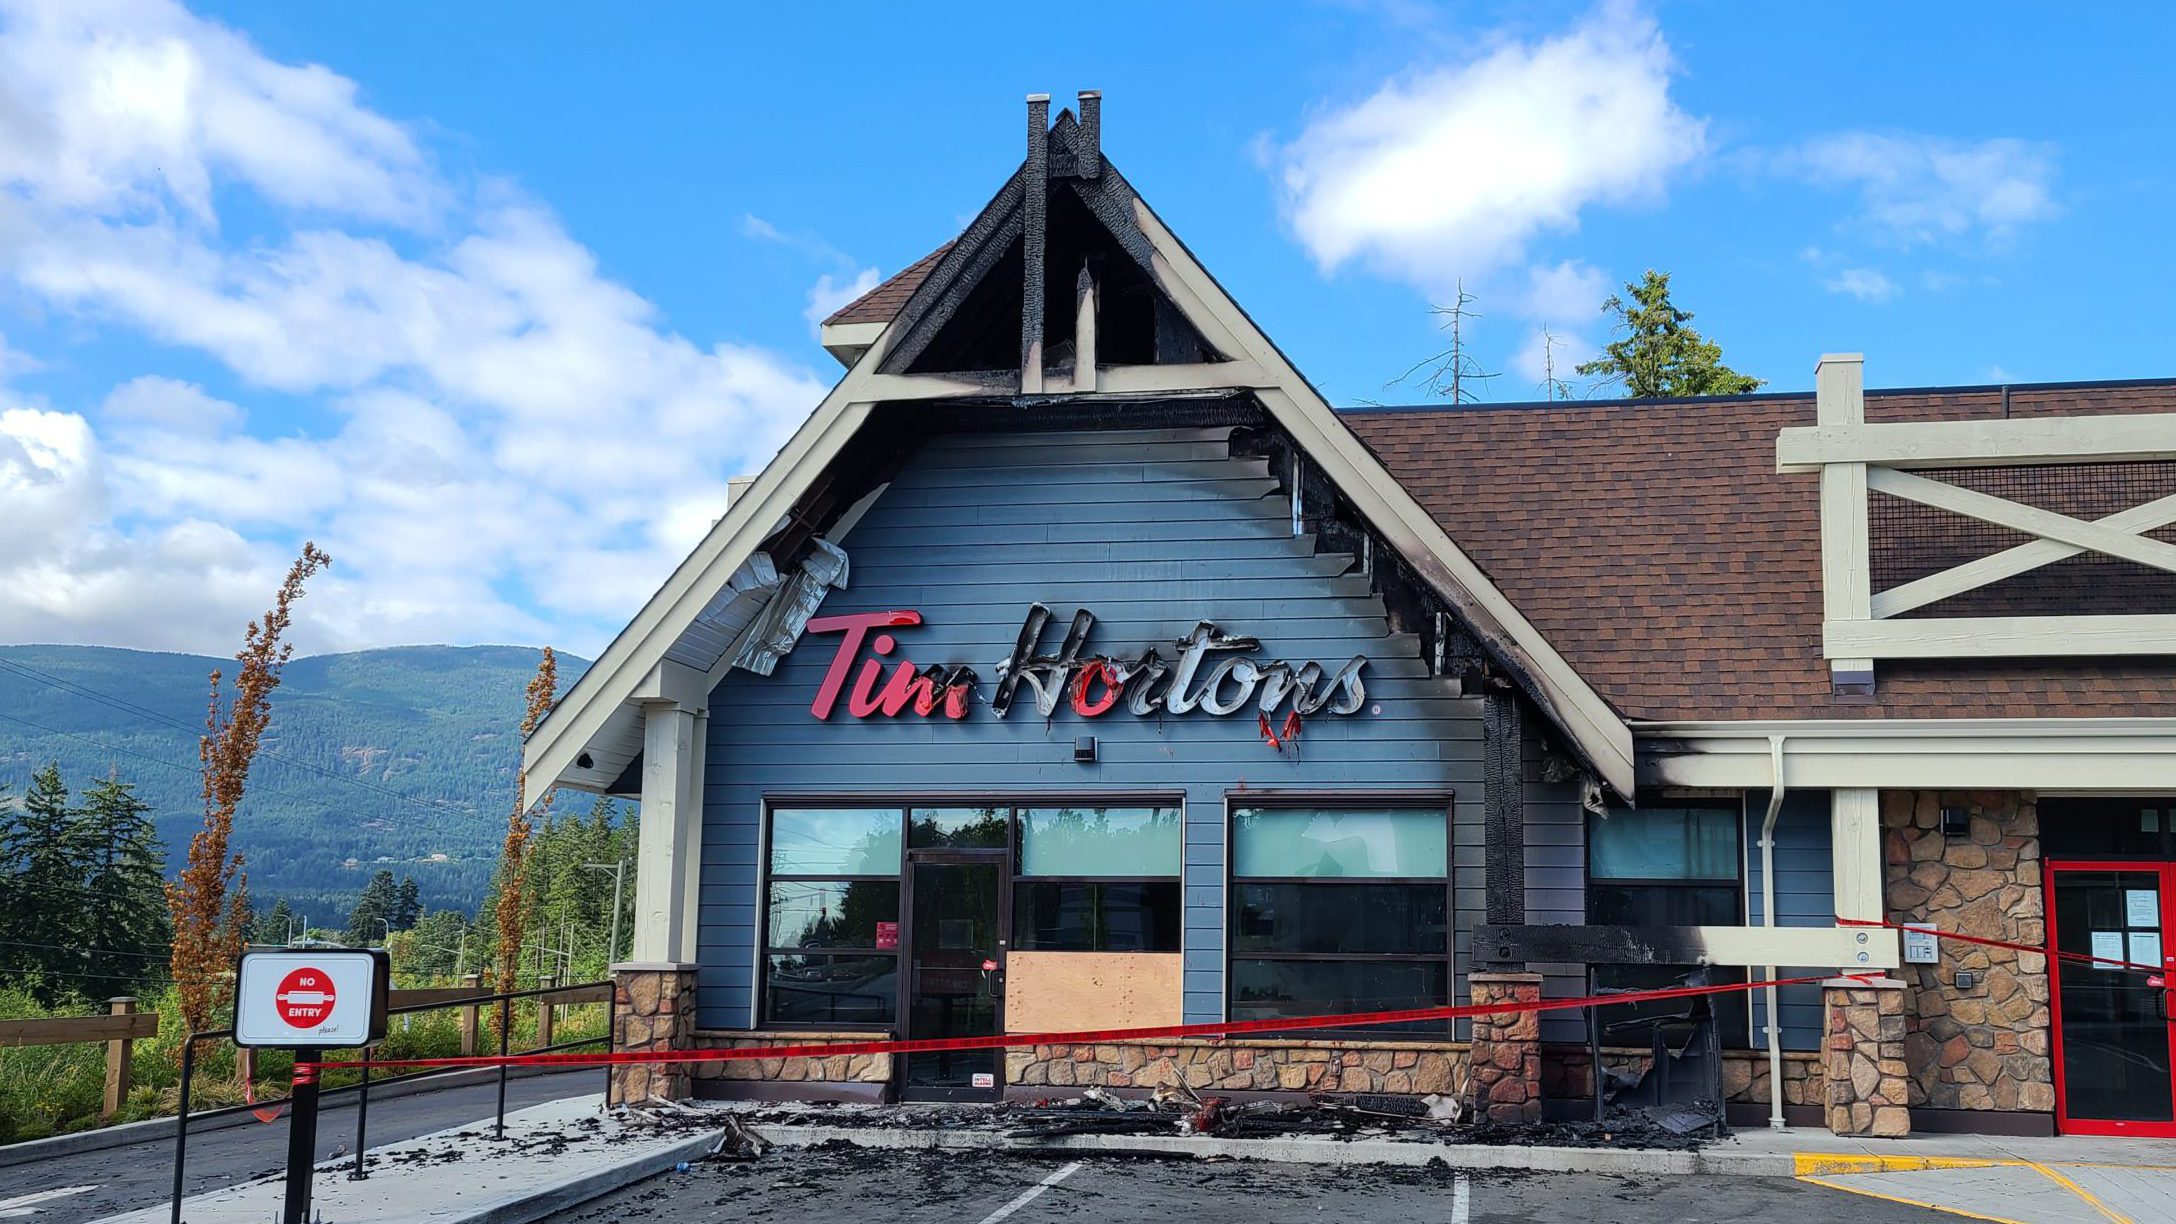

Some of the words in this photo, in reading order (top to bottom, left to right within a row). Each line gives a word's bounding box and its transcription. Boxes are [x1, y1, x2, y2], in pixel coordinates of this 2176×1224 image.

[806, 609, 985, 720] Tim
[992, 601, 1368, 719] Hortons
[300, 977, 315, 987] NO
[288, 1008, 322, 1017] ENTRY
[318, 1025, 339, 1036] please!
